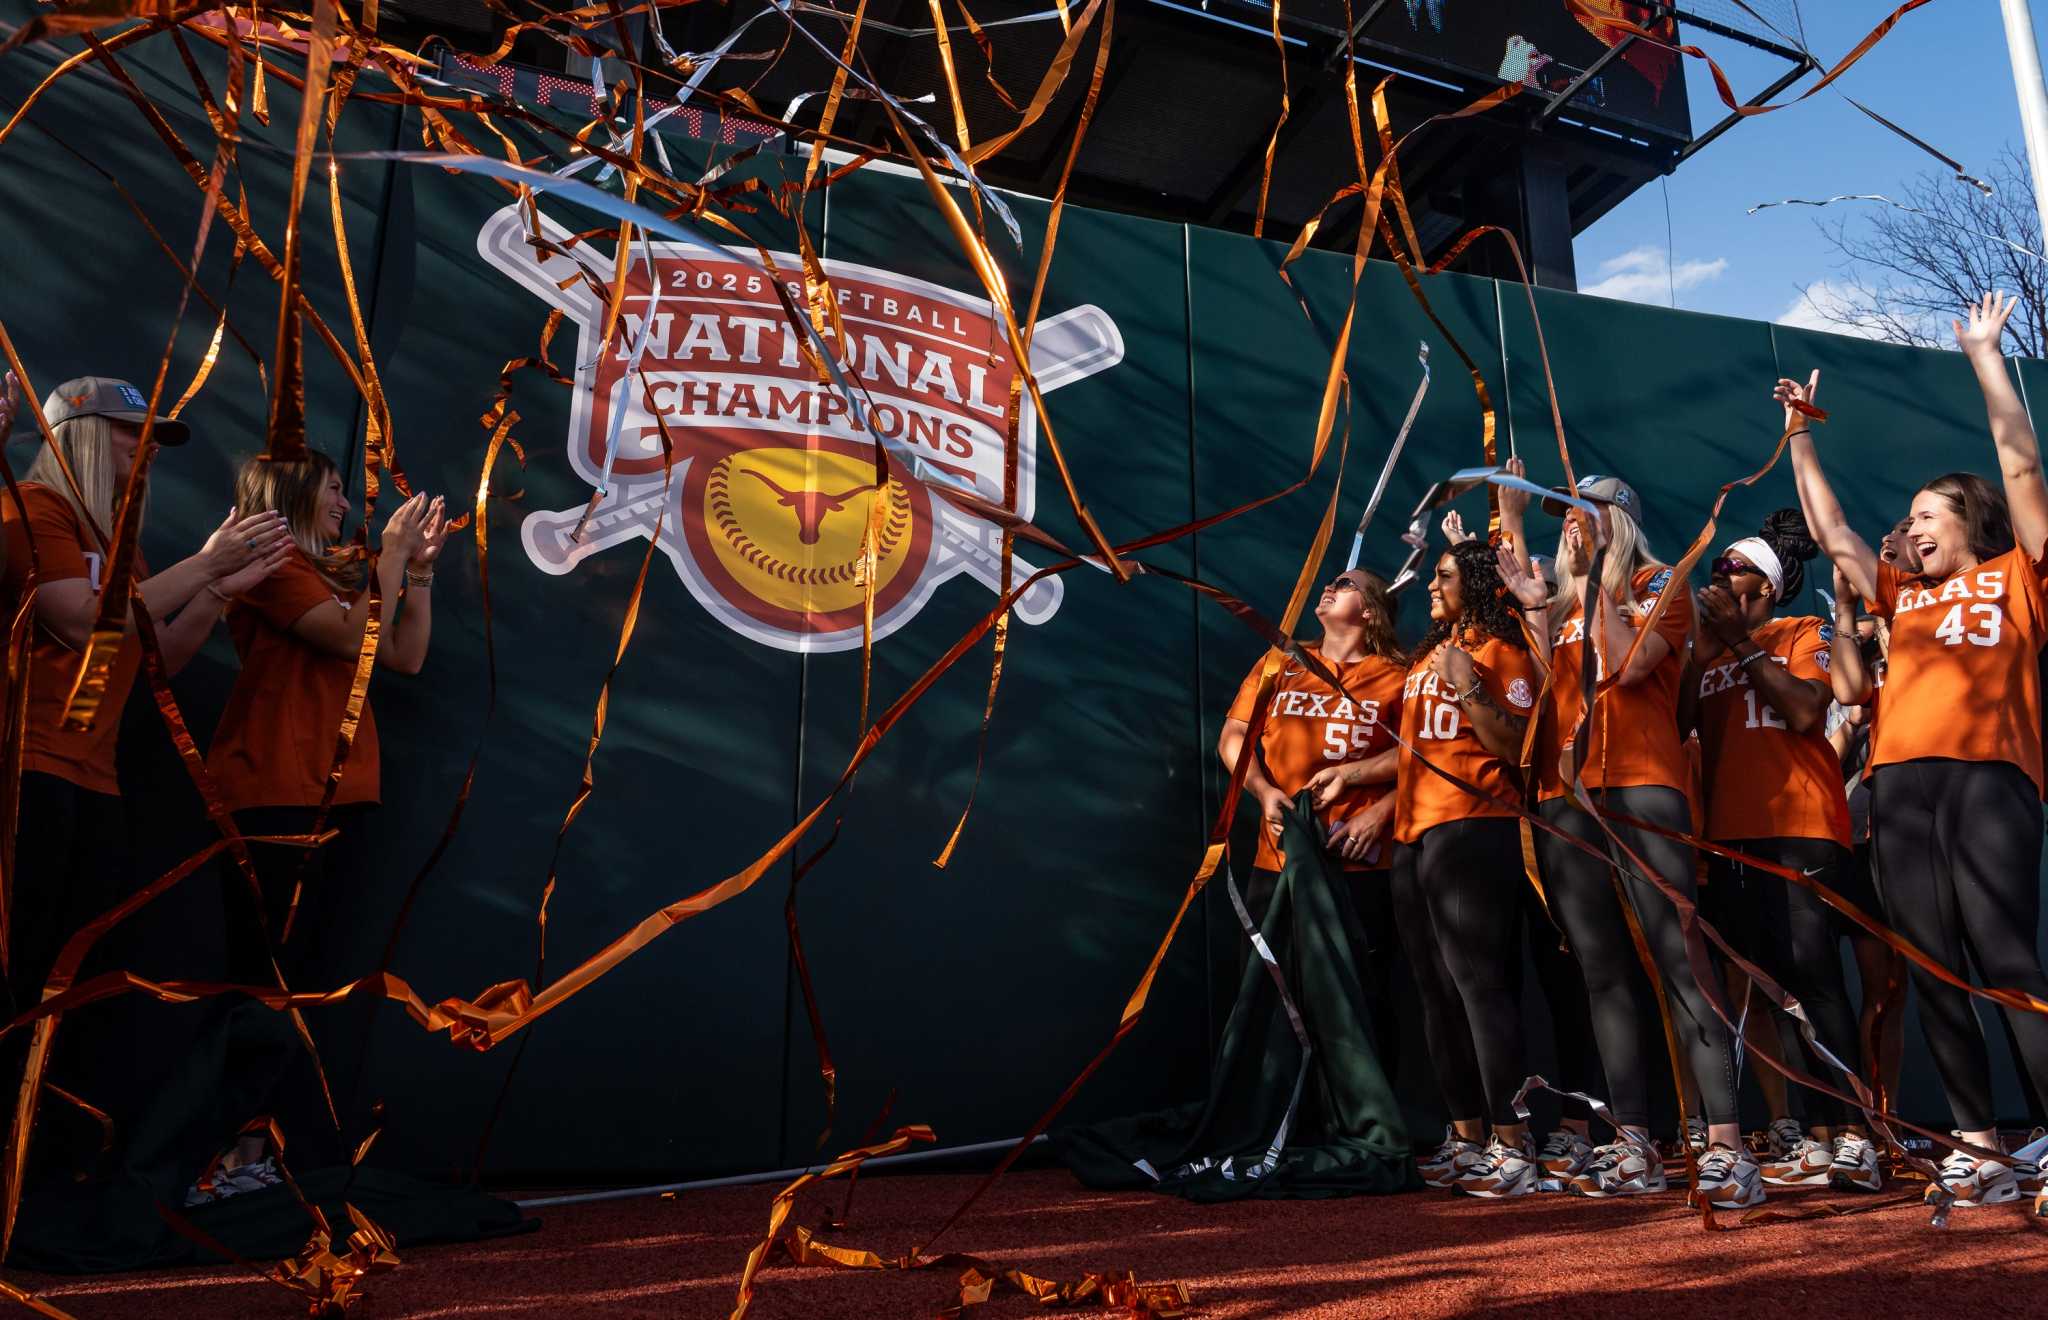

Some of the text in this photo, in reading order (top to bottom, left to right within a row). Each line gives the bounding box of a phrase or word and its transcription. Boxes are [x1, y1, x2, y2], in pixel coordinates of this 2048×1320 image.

[672, 270, 967, 336] 2025 SFTBALL
[1935, 602, 2003, 647] 43
[1418, 699, 1460, 739] 10
[1322, 722, 1374, 760] 55
